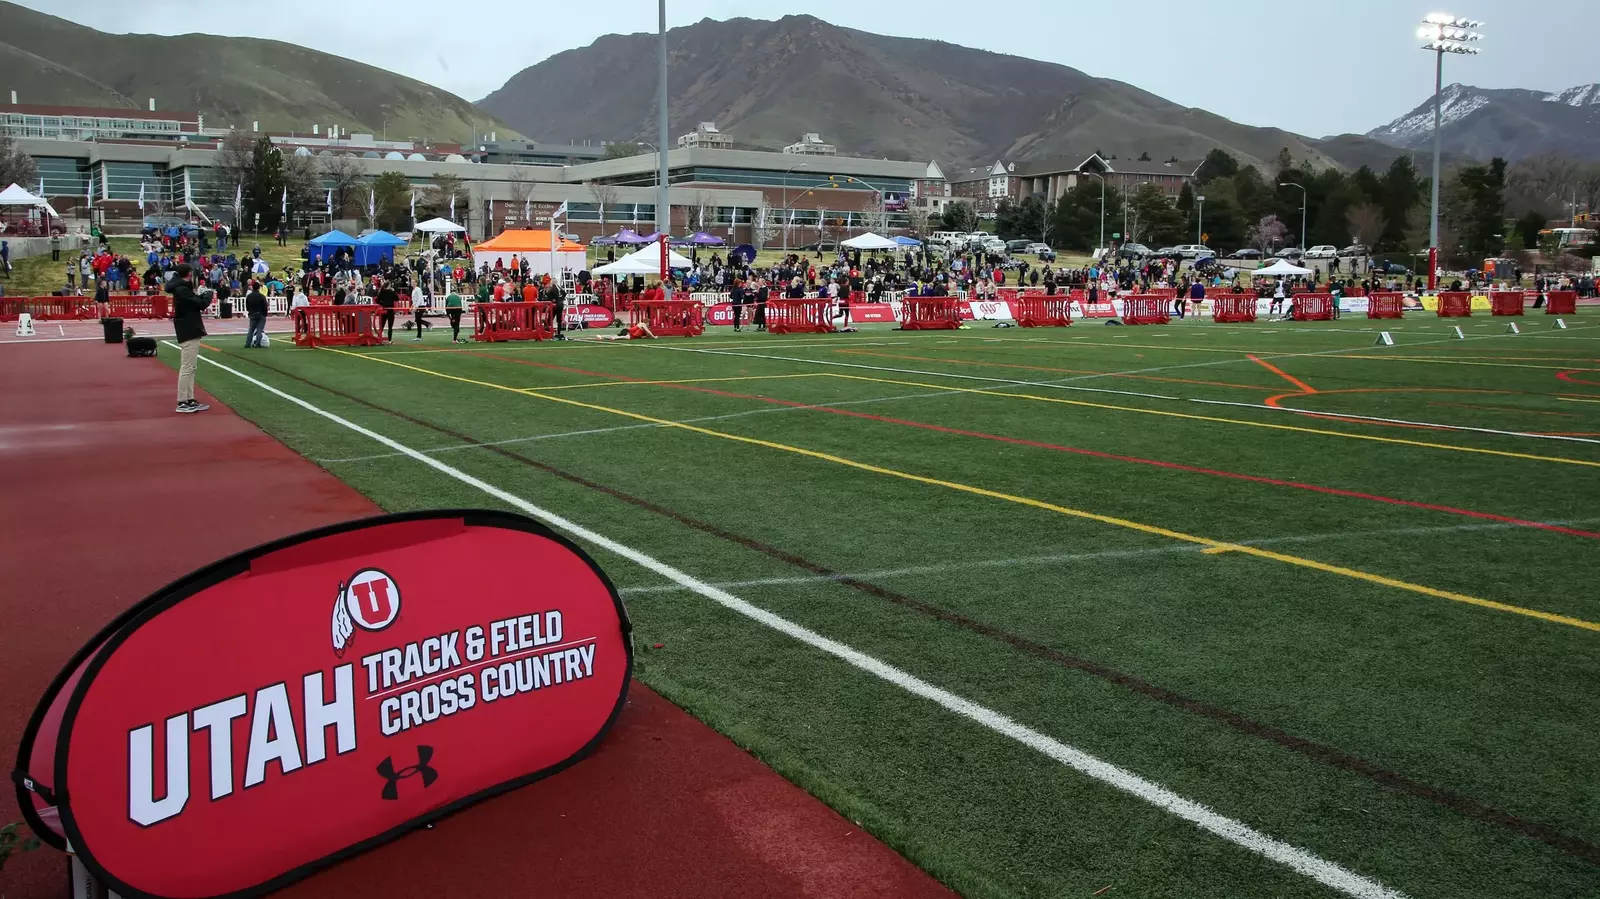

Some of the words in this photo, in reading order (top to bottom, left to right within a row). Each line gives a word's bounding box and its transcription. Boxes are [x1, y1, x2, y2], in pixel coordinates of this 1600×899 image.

[714, 311, 726, 321] GO
[351, 577, 392, 625] U
[362, 630, 462, 694] TRACK
[464, 625, 486, 662] &
[489, 609, 563, 656] FIELD
[379, 672, 476, 737] CROSS
[480, 643, 596, 703] COUNTRY
[128, 662, 358, 828] UTAH
